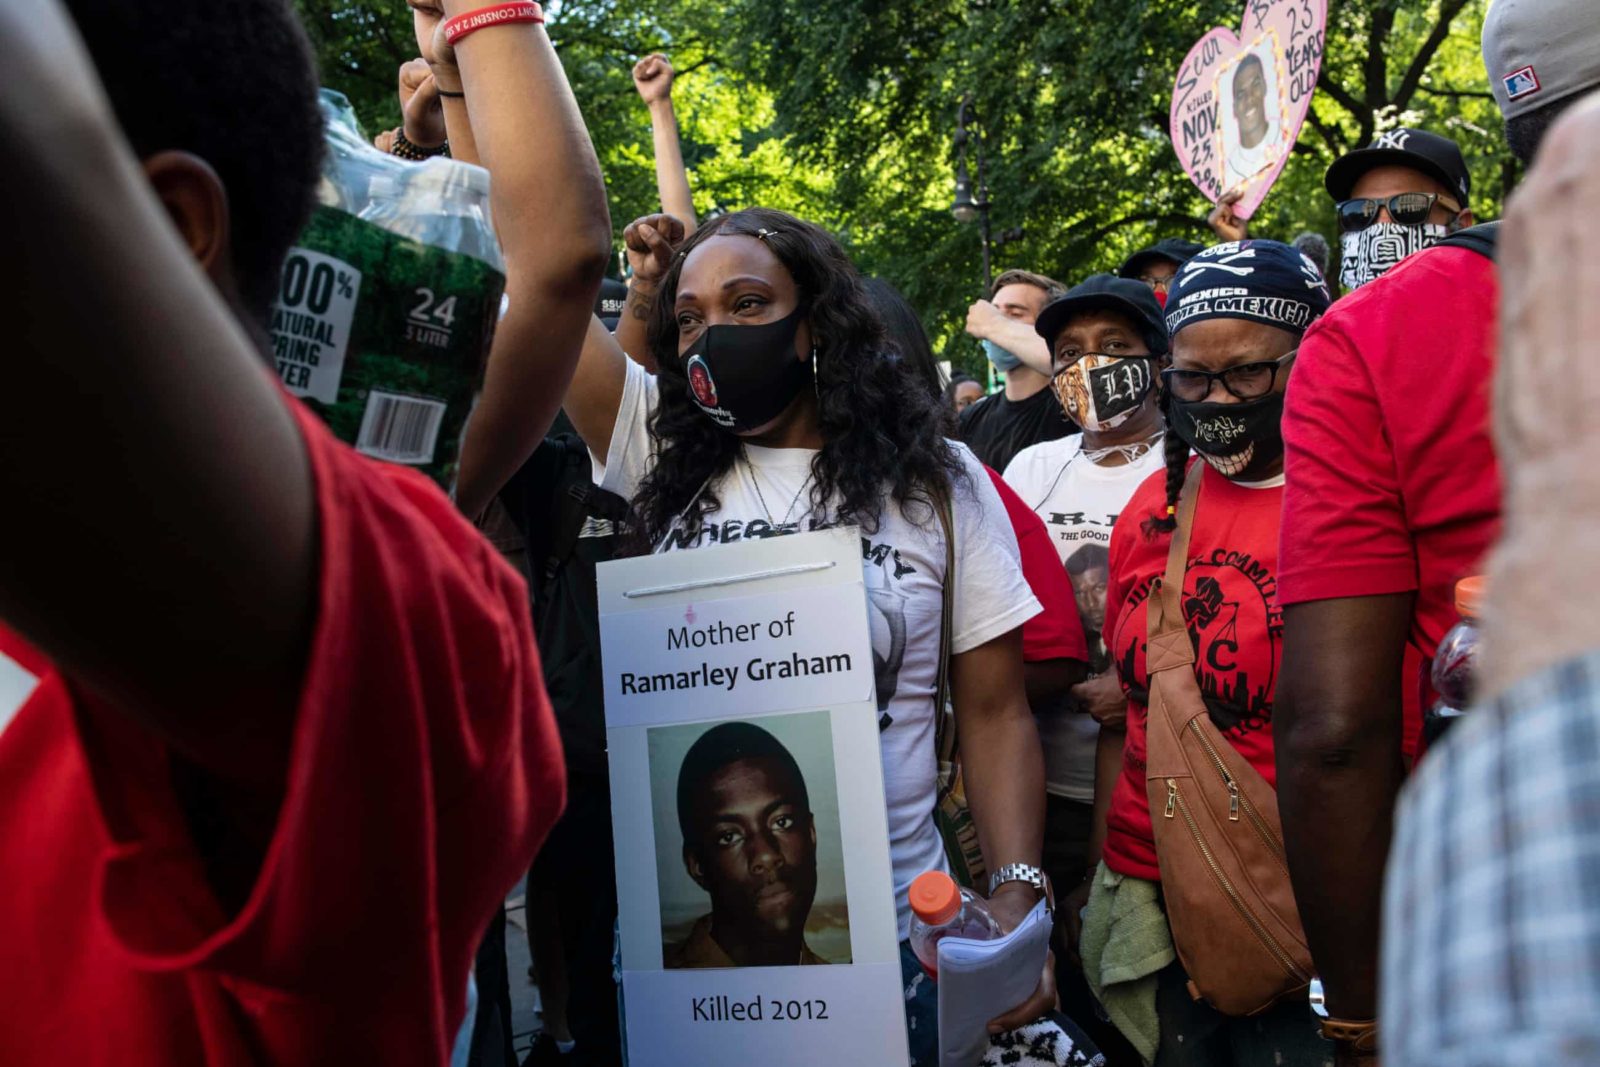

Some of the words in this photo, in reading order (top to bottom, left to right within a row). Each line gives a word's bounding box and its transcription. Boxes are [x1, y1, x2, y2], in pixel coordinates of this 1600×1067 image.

[455, 23, 461, 31] A
[462, 19, 469, 29] 2
[471, 8, 515, 27] CONSENT
[517, 6, 539, 17] ON'T
[1287, 0, 1313, 43] 23
[1286, 30, 1323, 76] YEARS
[1176, 37, 1222, 113] Sean
[1290, 69, 1317, 103] OLD
[1193, 168, 1222, 199] 2006
[282, 255, 354, 315] 00%
[1179, 287, 1248, 308] MEXICO
[410, 287, 458, 327] 24
[1215, 297, 1310, 329] MEXICO
[270, 309, 336, 348] ATURAL
[269, 333, 321, 367] PRING
[278, 360, 312, 390] TER
[1061, 532, 1079, 541] THE
[1081, 529, 1109, 542] GOOD
[667, 621, 760, 651] Mother
[768, 611, 796, 639] of
[621, 661, 740, 696] Ramarley
[746, 652, 852, 683] Graham
[692, 995, 763, 1021] Killed
[771, 1000, 829, 1020] 2012
